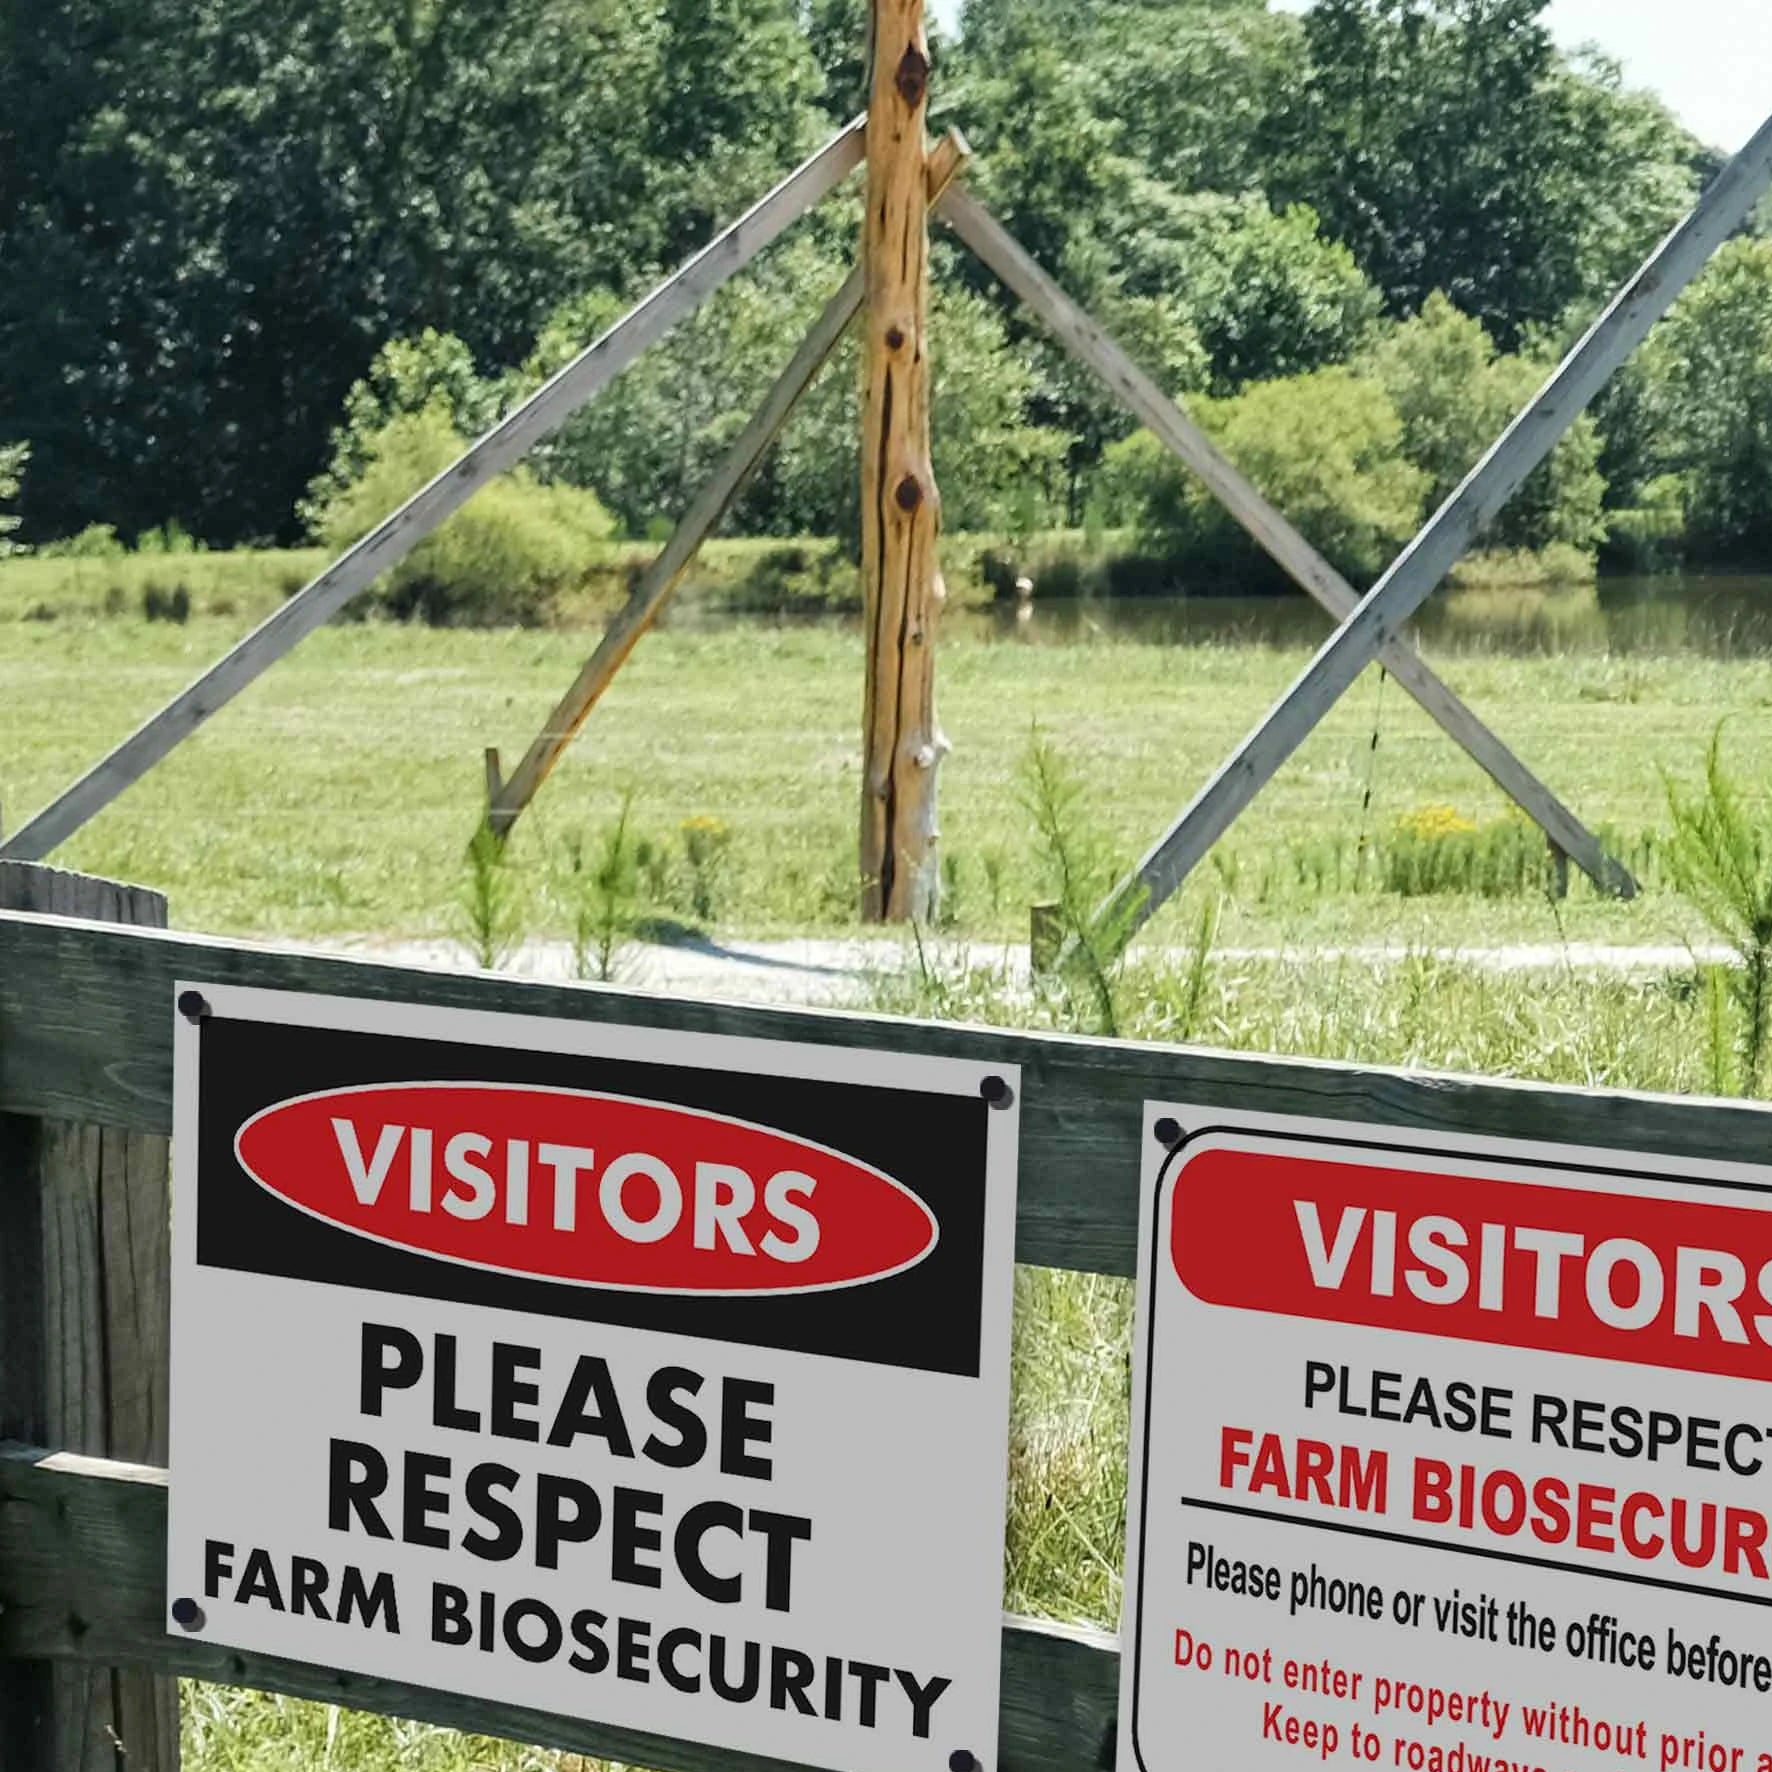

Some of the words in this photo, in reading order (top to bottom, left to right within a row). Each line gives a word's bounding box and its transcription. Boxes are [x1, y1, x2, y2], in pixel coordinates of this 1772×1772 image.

[330, 1117, 820, 1263] VISITORS
[359, 1321, 775, 1482] PLEASE
[1219, 1425, 1389, 1514] FARM
[1304, 1359, 1514, 1440] PLEASE
[328, 1437, 812, 1613] RESPECT
[204, 1538, 401, 1635] FARM
[431, 1581, 953, 1739] BIOSECURITY
[1186, 1541, 1281, 1601] Please
[1289, 1563, 1384, 1620] phone
[1392, 1590, 1426, 1628] or
[1433, 1588, 1499, 1643] visit
[1506, 1600, 1557, 1653] the
[1565, 1613, 1656, 1672] office
[1666, 1627, 1772, 1693] before
[1174, 1628, 1212, 1671] Do
[1224, 1648, 1272, 1683] not
[1283, 1660, 1363, 1701] enter
[1374, 1678, 1510, 1741] property
[1521, 1702, 1647, 1759] without
[1263, 1701, 1339, 1761] Keep
[1351, 1722, 1381, 1761] to
